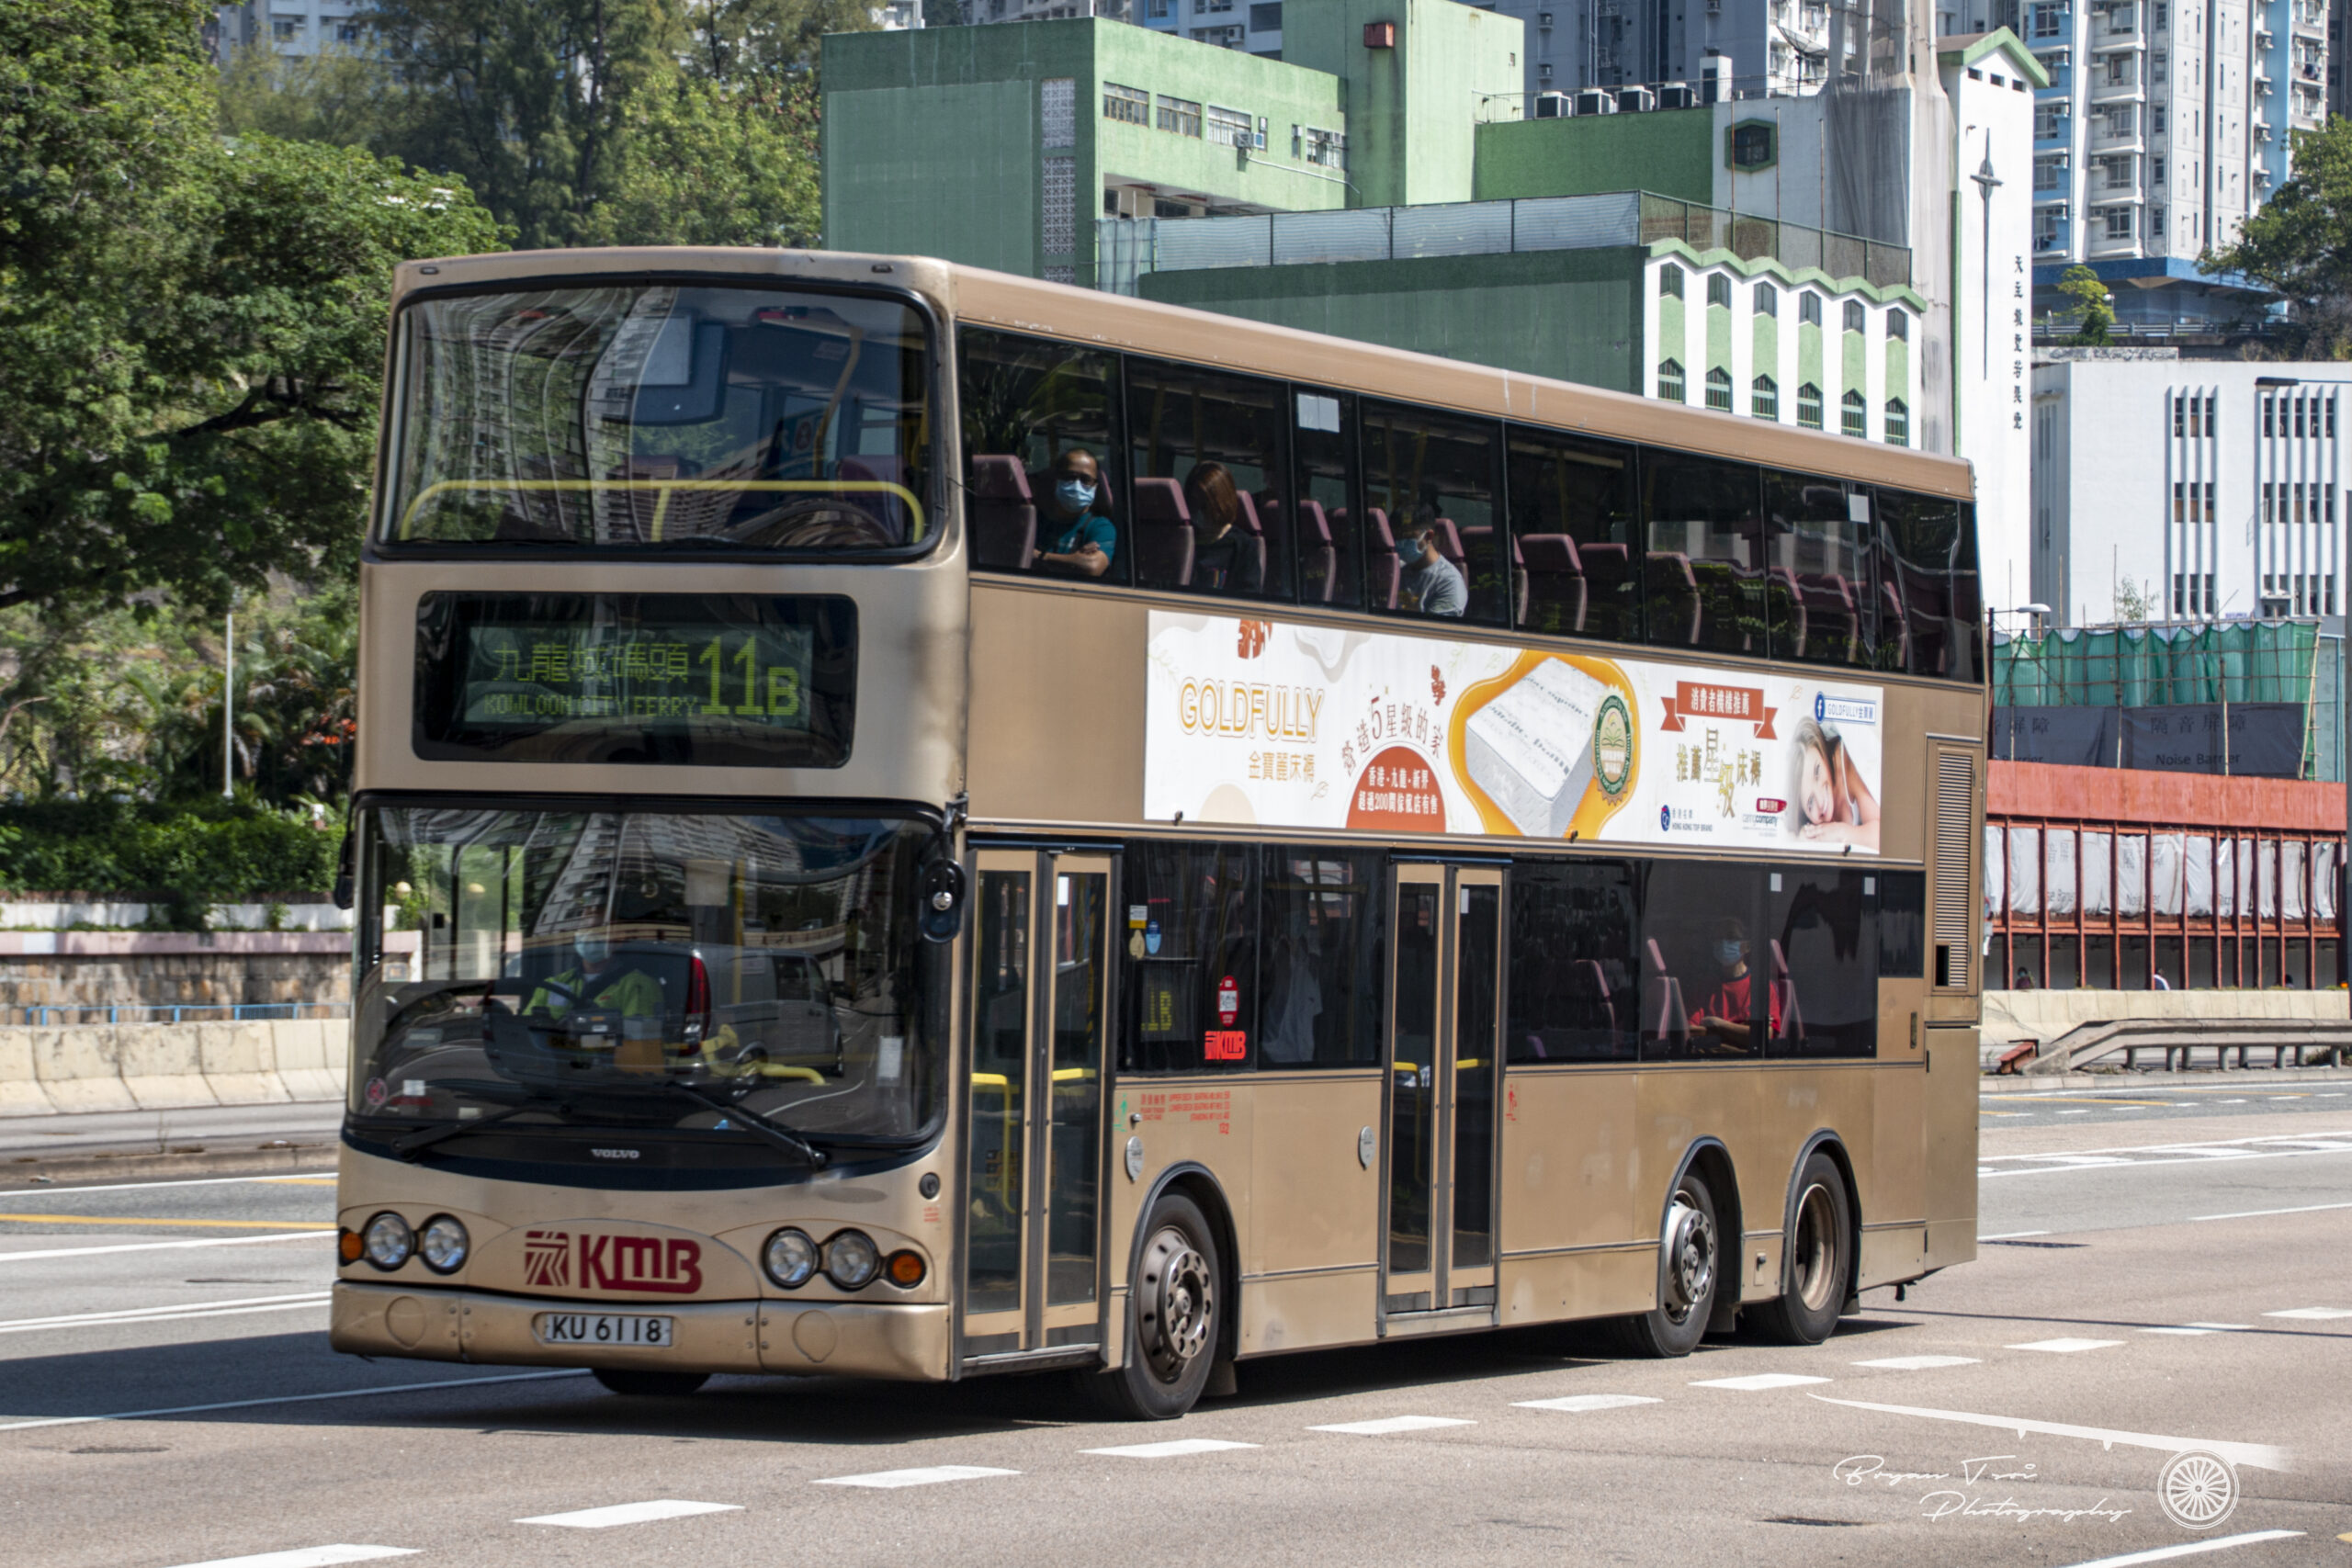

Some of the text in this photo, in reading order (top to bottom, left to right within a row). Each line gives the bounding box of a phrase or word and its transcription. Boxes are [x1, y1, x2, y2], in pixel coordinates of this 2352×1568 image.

[492, 642, 688, 683] 九龍城碼頭
[699, 635, 799, 716] 11B
[484, 694, 571, 716] KOWLOON
[634, 695, 697, 716] FERRY
[1180, 681, 1323, 739] GOLDFULLY
[2154, 752, 2242, 766] Noise Barrer
[1216, 1031, 1246, 1060] KMB
[591, 1148, 640, 1159] VOLVO
[579, 1234, 703, 1294] KMB
[552, 1315, 662, 1342] KU 6118
